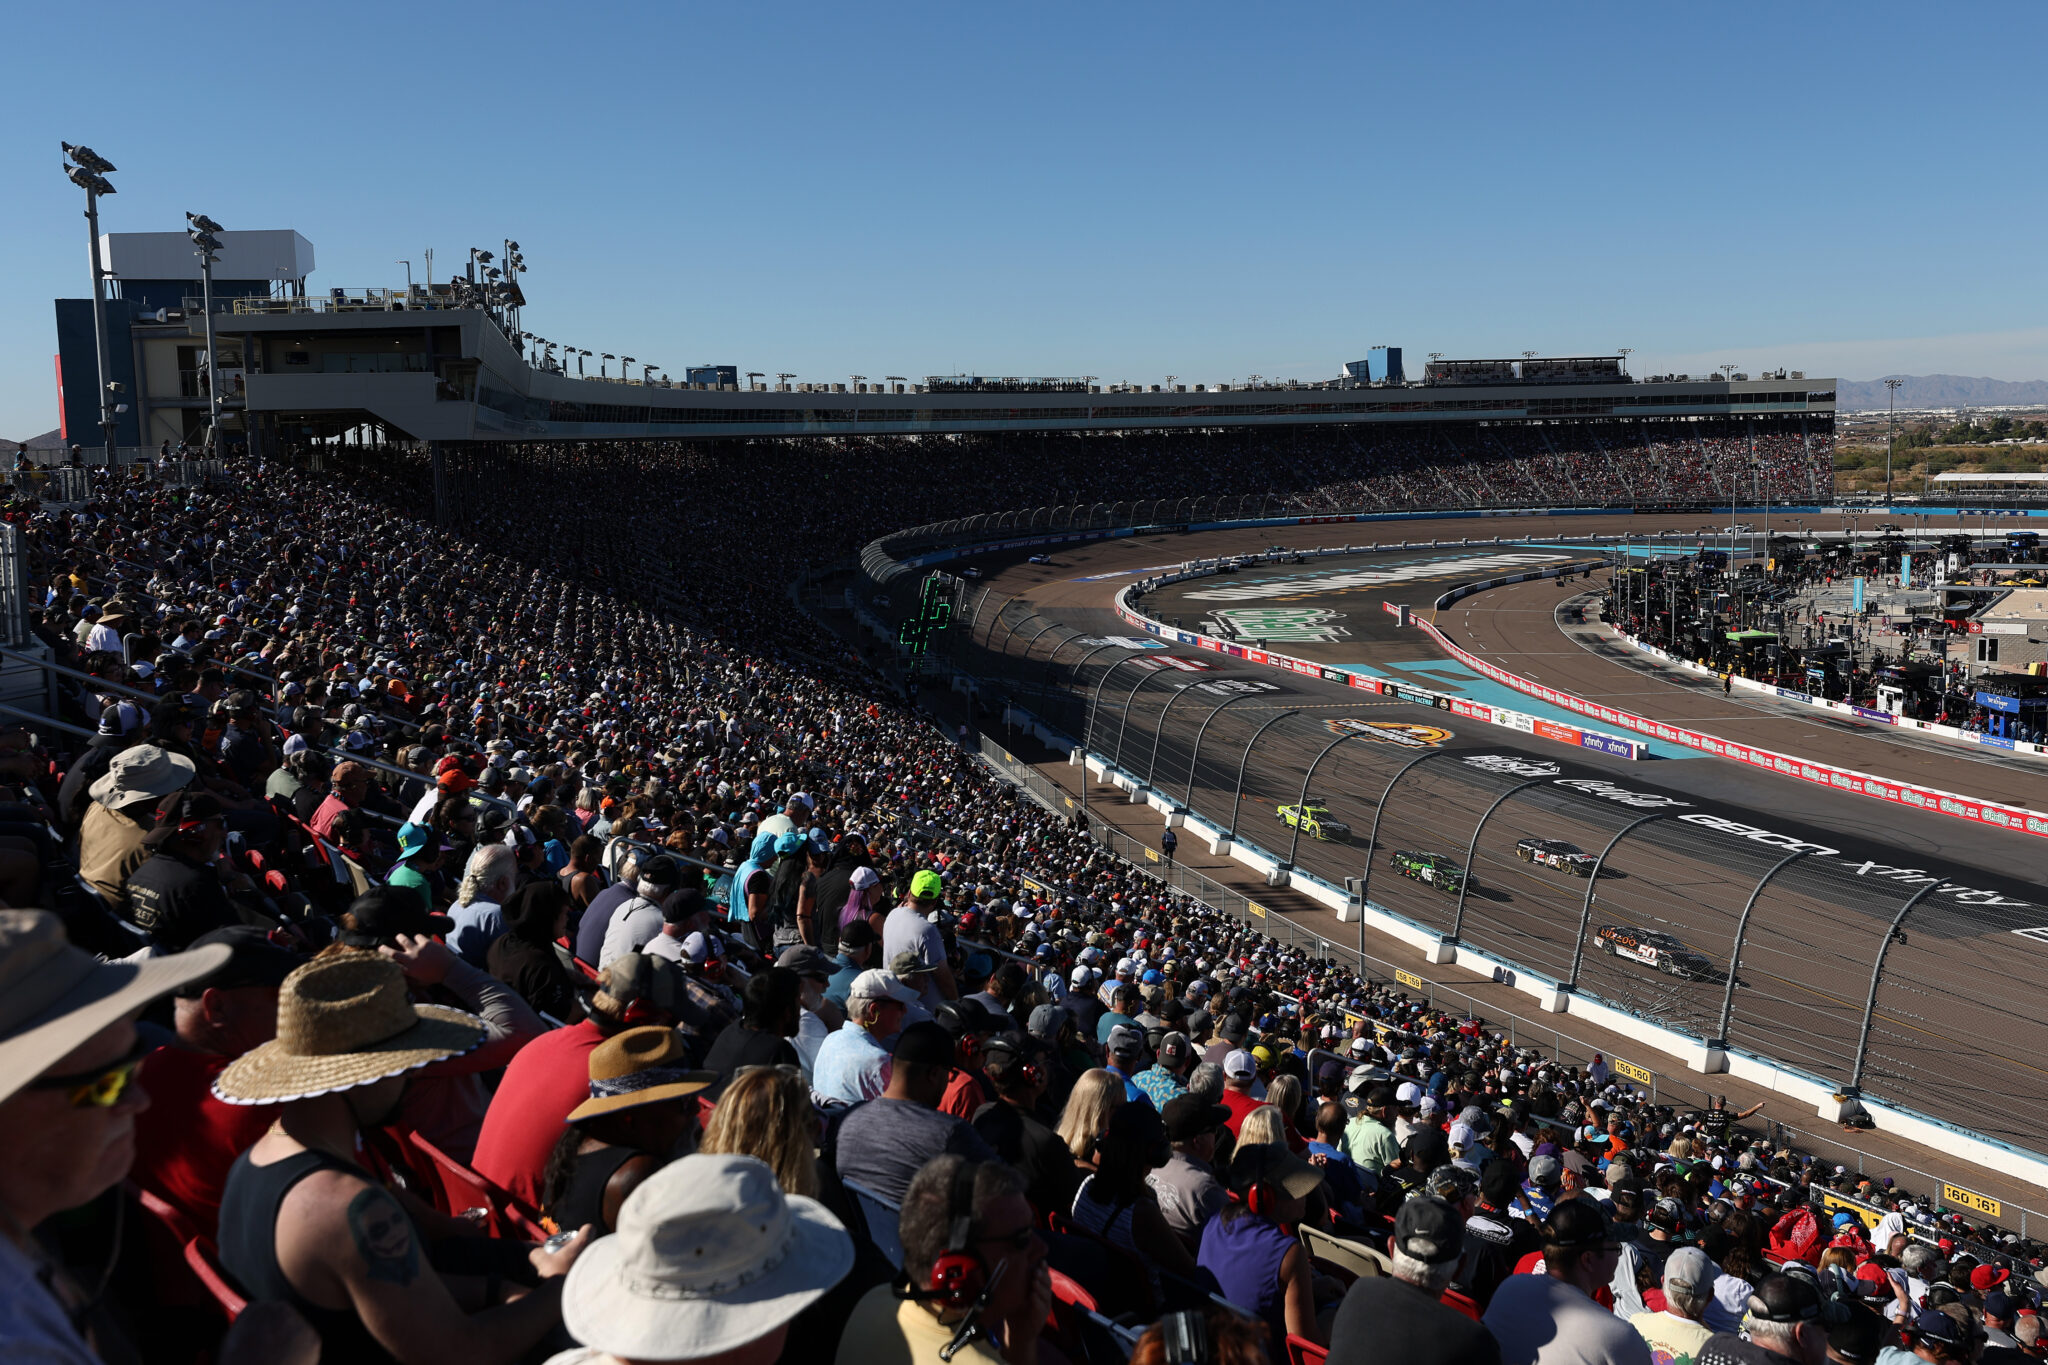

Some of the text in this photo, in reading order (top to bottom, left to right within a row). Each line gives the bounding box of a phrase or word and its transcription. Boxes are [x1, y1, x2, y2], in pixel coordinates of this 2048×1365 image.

[1398, 692, 1414, 702] PHOENIX
[1415, 696, 1433, 706] RACEWAY
[1584, 735, 1603, 749] xfinity
[1608, 741, 1628, 756] xfinity
[1901, 789, 1926, 807] O'Reilly
[1940, 798, 1966, 817] O'Reilly
[1981, 807, 2010, 826] O'Reilly
[1677, 814, 1840, 856] GEICO
[1638, 944, 1658, 959] 50
[1408, 976, 1420, 987] 159
[1617, 1062, 1648, 1081] 159 160
[1946, 1187, 1995, 1213] 160 161
